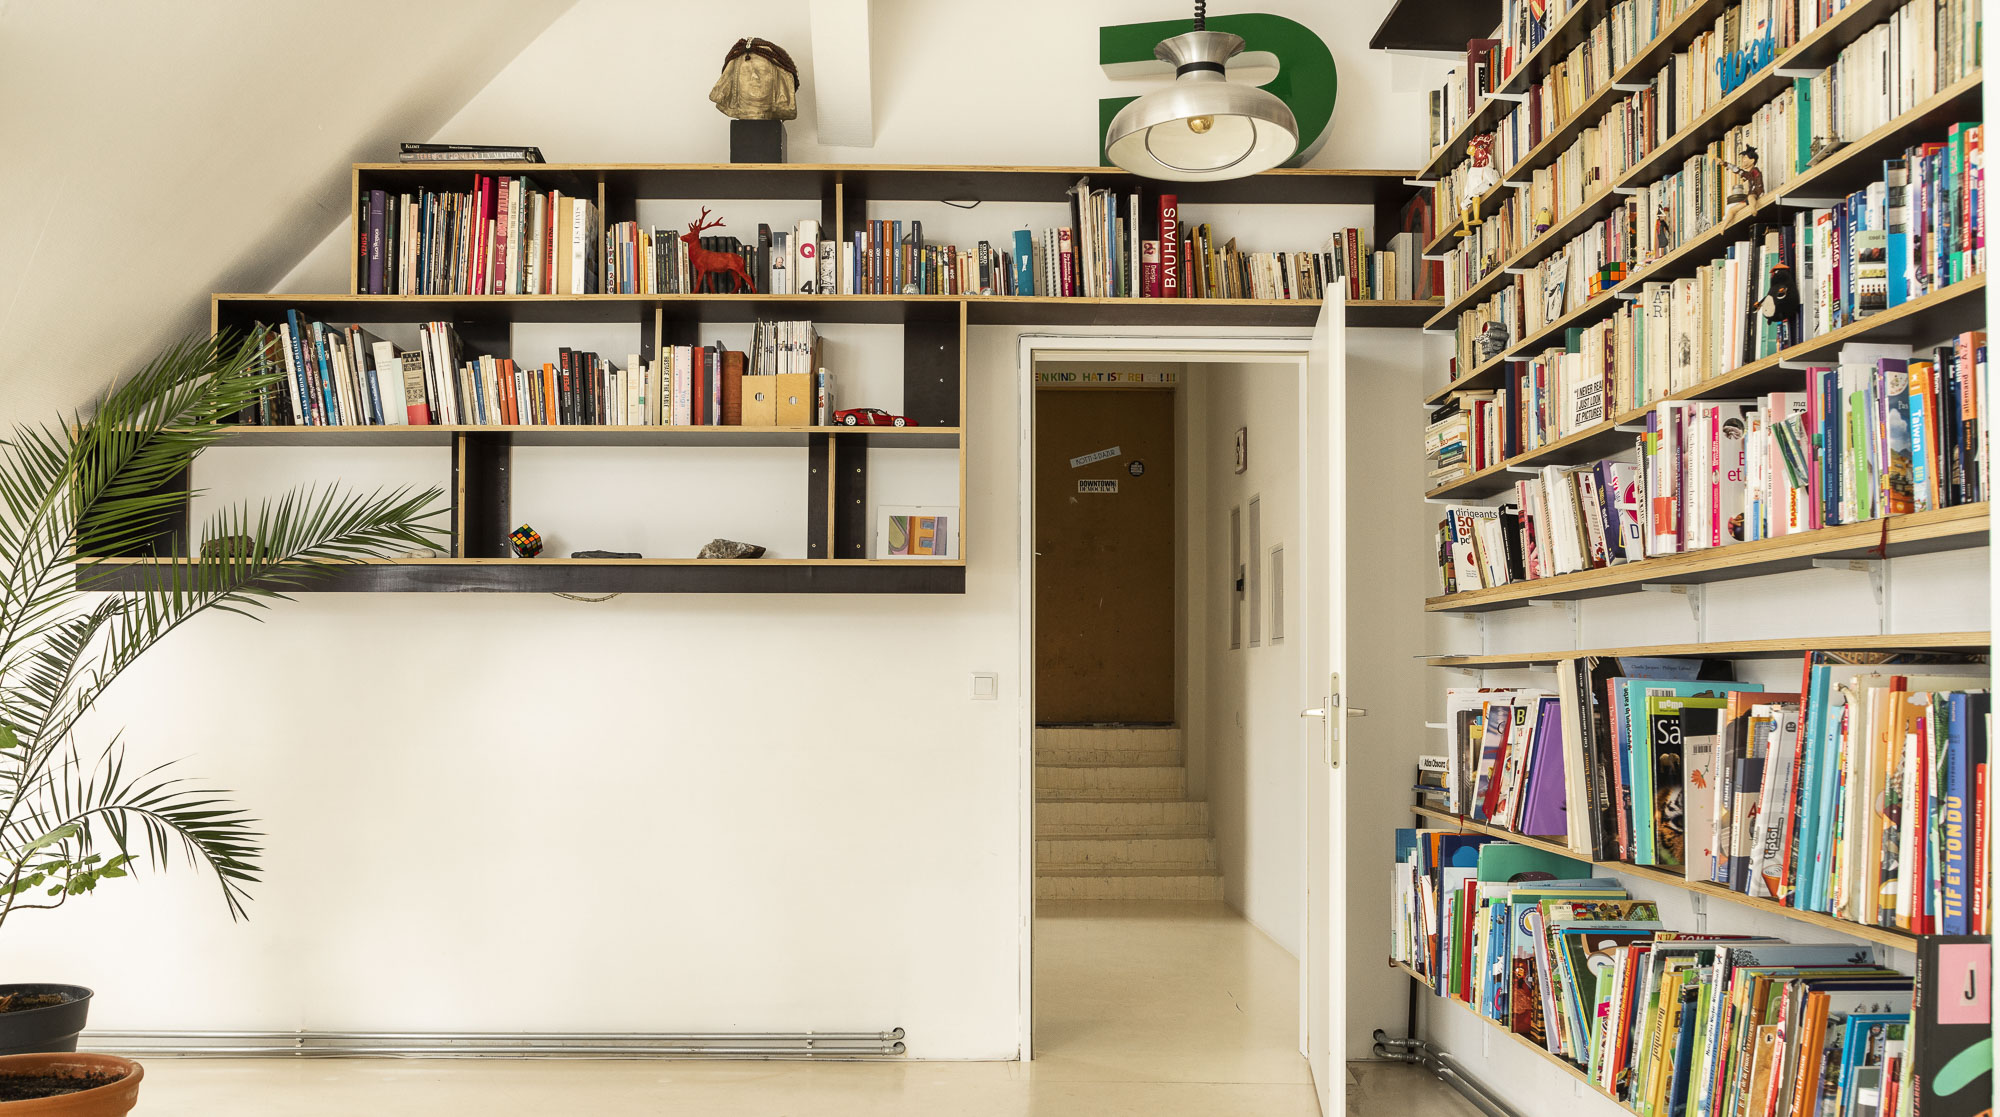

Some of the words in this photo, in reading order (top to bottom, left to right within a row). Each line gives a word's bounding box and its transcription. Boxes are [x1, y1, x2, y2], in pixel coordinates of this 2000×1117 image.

[1950, 141, 1958, 174] SICILE
[800, 243, 816, 259] Q
[1164, 207, 1177, 288] BAUHAUS
[1653, 304, 1663, 318] R
[561, 352, 569, 369] HITLER
[298, 373, 306, 398] JARDINS
[563, 375, 571, 392] SPEER
[1050, 372, 1077, 382] KIND
[1082, 372, 1104, 382] HAT
[1107, 372, 1123, 382] IST
[1594, 379, 1604, 391] REA
[1578, 397, 1590, 409] JUST
[1590, 394, 1602, 405] LOOK
[1576, 412, 1581, 422] AT
[1581, 406, 1602, 421] PICTURES
[1912, 409, 1922, 452] Taiwan
[1727, 467, 1742, 482] et
[1455, 508, 1498, 520] dirigeants
[1457, 516, 1474, 529] 50
[1516, 709, 1525, 725] B
[1657, 719, 1681, 745] Sä
[1747, 801, 1758, 818] A
[1946, 796, 1962, 862] TONDU
[1975, 813, 1983, 828] plus
[1763, 827, 1779, 859] tiptoi
[1946, 864, 1960, 885] ET
[1972, 887, 1981, 915] Loup
[1964, 969, 1975, 1000] J
[1652, 1007, 1666, 1062] Bauernhof
